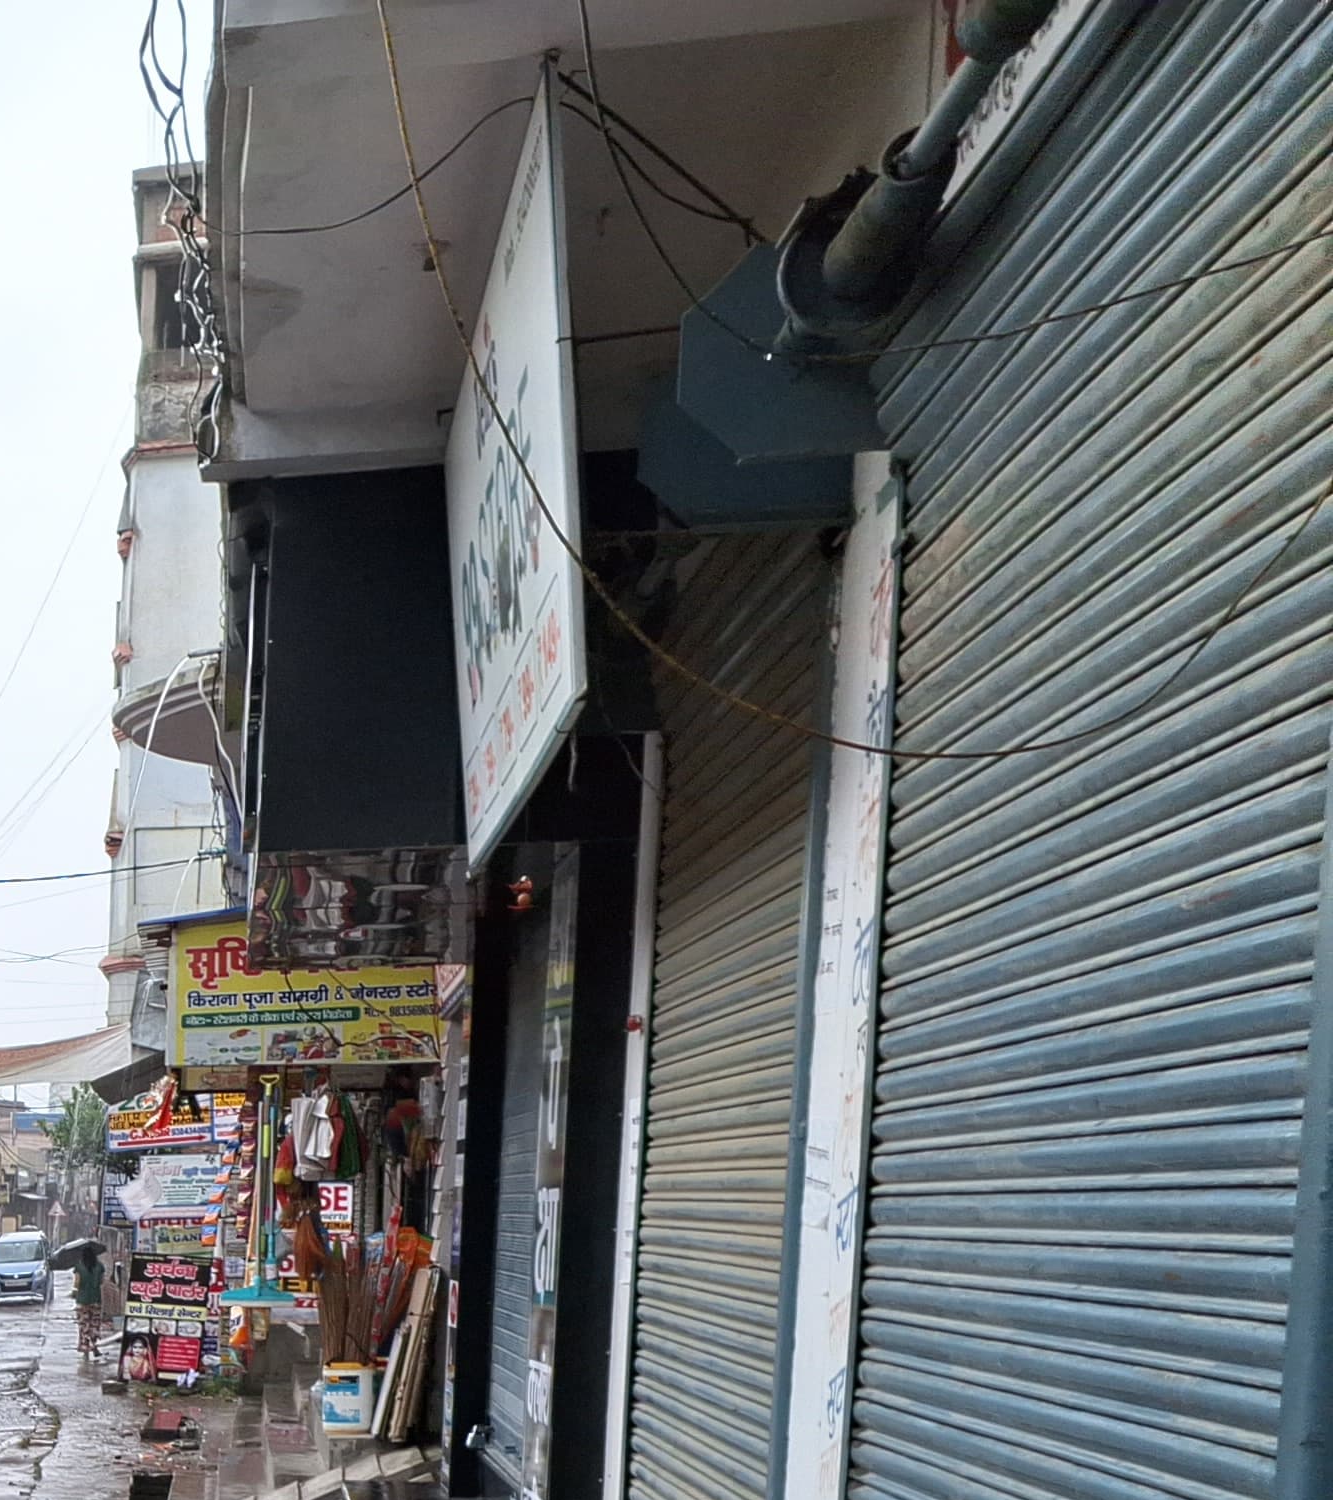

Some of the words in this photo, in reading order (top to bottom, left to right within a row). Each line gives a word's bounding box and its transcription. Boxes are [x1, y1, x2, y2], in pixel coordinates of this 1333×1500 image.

[477, 362, 541, 650] STORE
[187, 990, 238, 1008] किराना
[242, 991, 274, 1010] पूजा
[278, 984, 330, 1005] सामग्री
[334, 985, 344, 1000] &
[349, 981, 401, 1000] जेनरल
[144, 1260, 199, 1280] अर्चना
[129, 1279, 165, 1302] ब्यूटी
[165, 1281, 208, 1300] पार्लर
